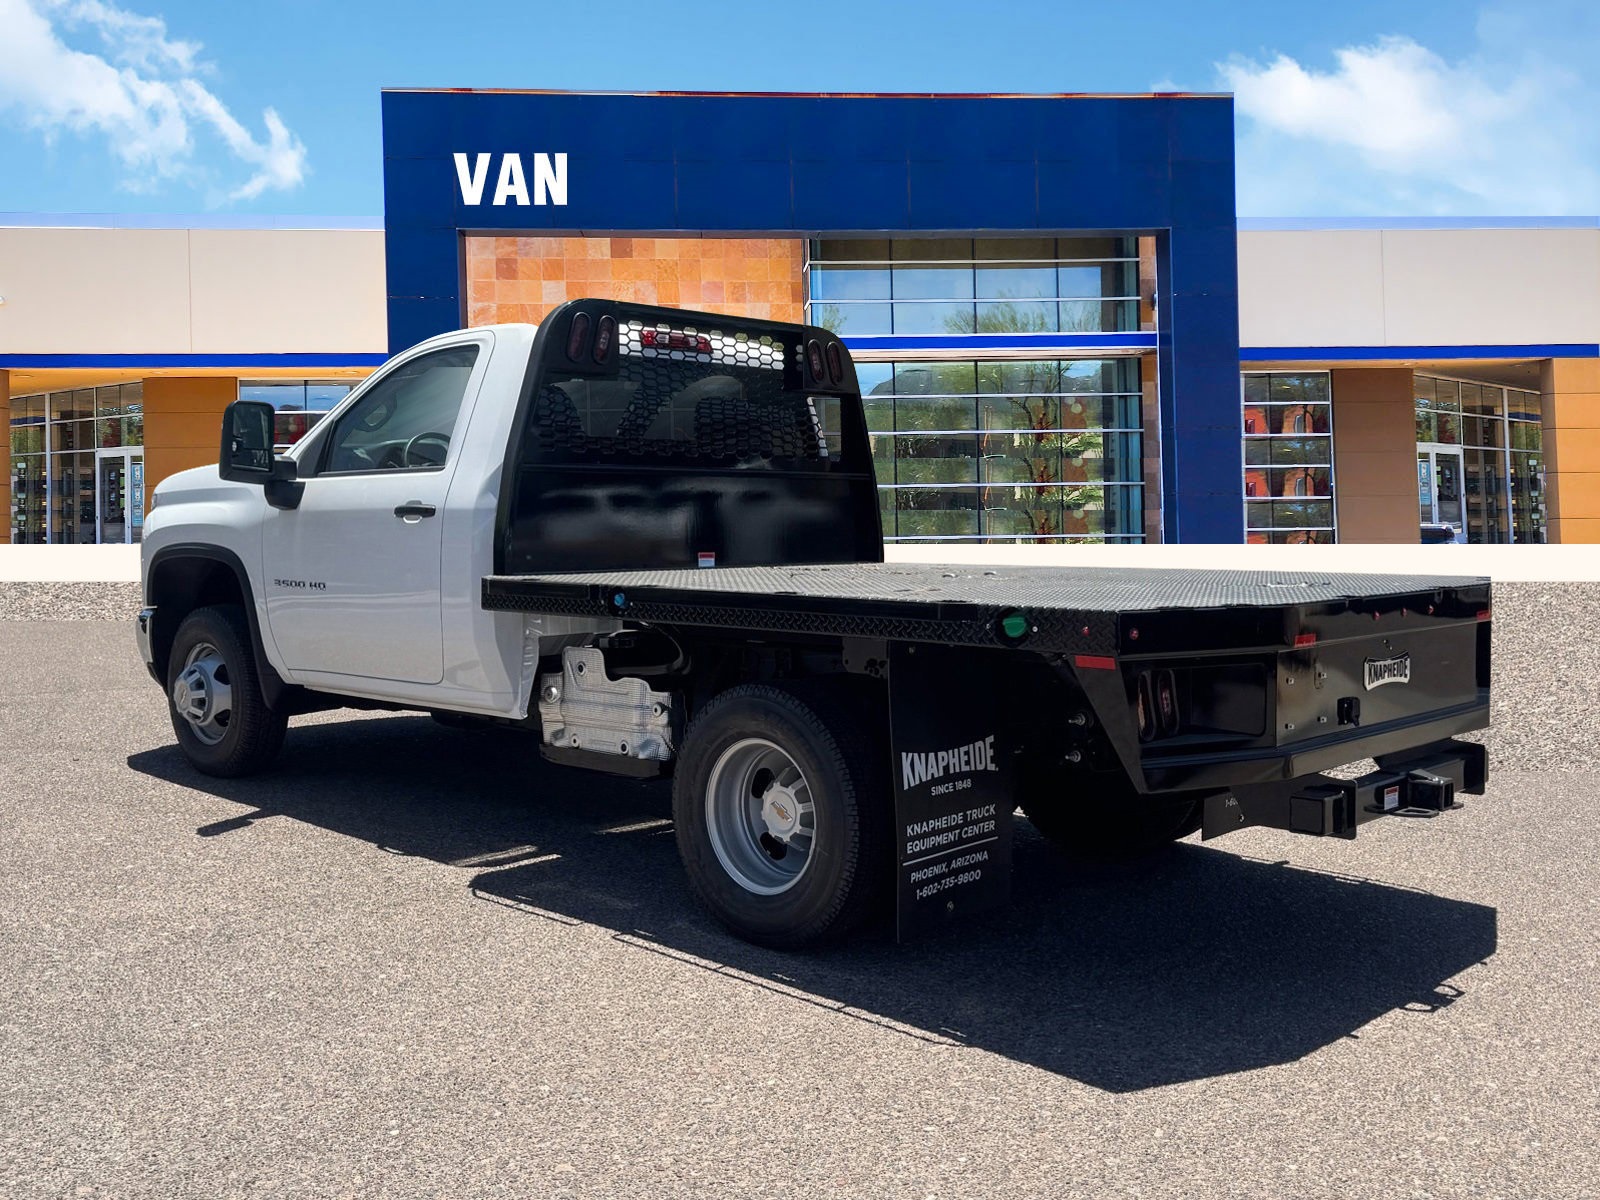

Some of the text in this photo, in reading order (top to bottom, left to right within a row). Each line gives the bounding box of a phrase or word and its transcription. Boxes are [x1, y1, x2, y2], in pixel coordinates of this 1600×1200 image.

[453, 153, 568, 206] VAN
[274, 578, 306, 589] 3500
[1368, 659, 1409, 686] KNAPHEIDE
[901, 735, 996, 790] KNAPHEIDE
[931, 778, 972, 796] SINCE 1848
[906, 804, 996, 837] KNAPHEIDE TRUCK
[906, 820, 996, 854] EQUIPMENT CENTER
[910, 850, 989, 884] PHOENIX, ARIZONA
